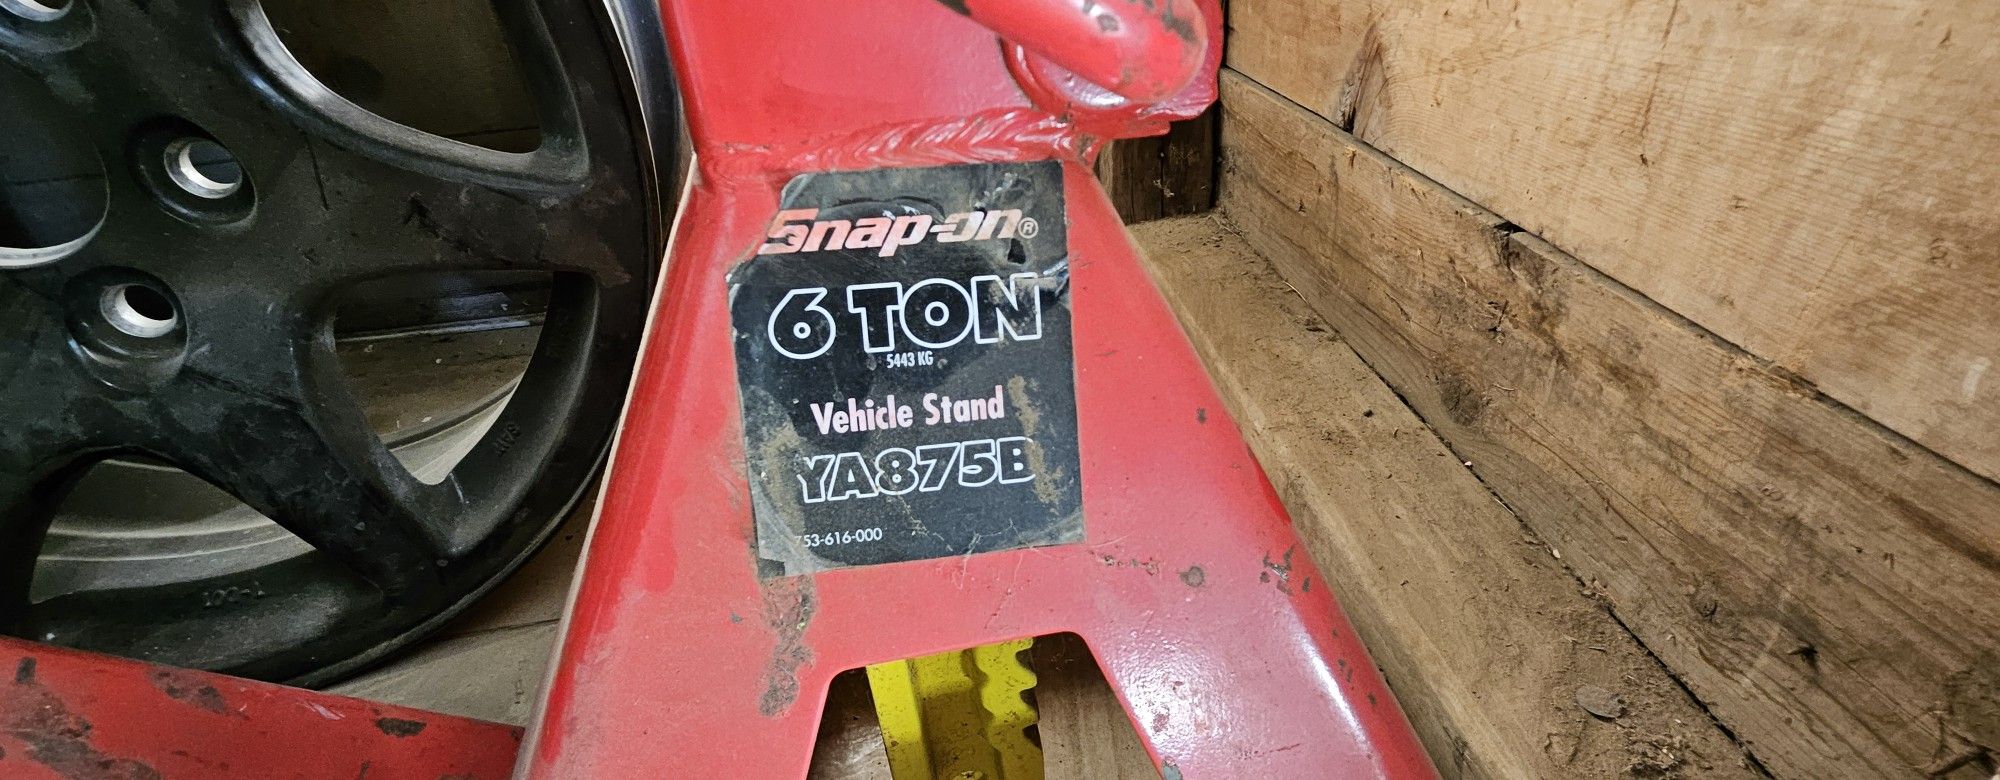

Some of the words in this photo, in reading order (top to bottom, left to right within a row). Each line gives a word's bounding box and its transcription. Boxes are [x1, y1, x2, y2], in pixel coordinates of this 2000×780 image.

[767, 286, 837, 360] 6
[846, 271, 1043, 353] TON
[886, 351, 916, 369] 5443
[917, 350, 934, 366] KG
[810, 394, 914, 435] Vehicle
[922, 384, 1005, 426] Stand
[796, 436, 1037, 503] YA875B
